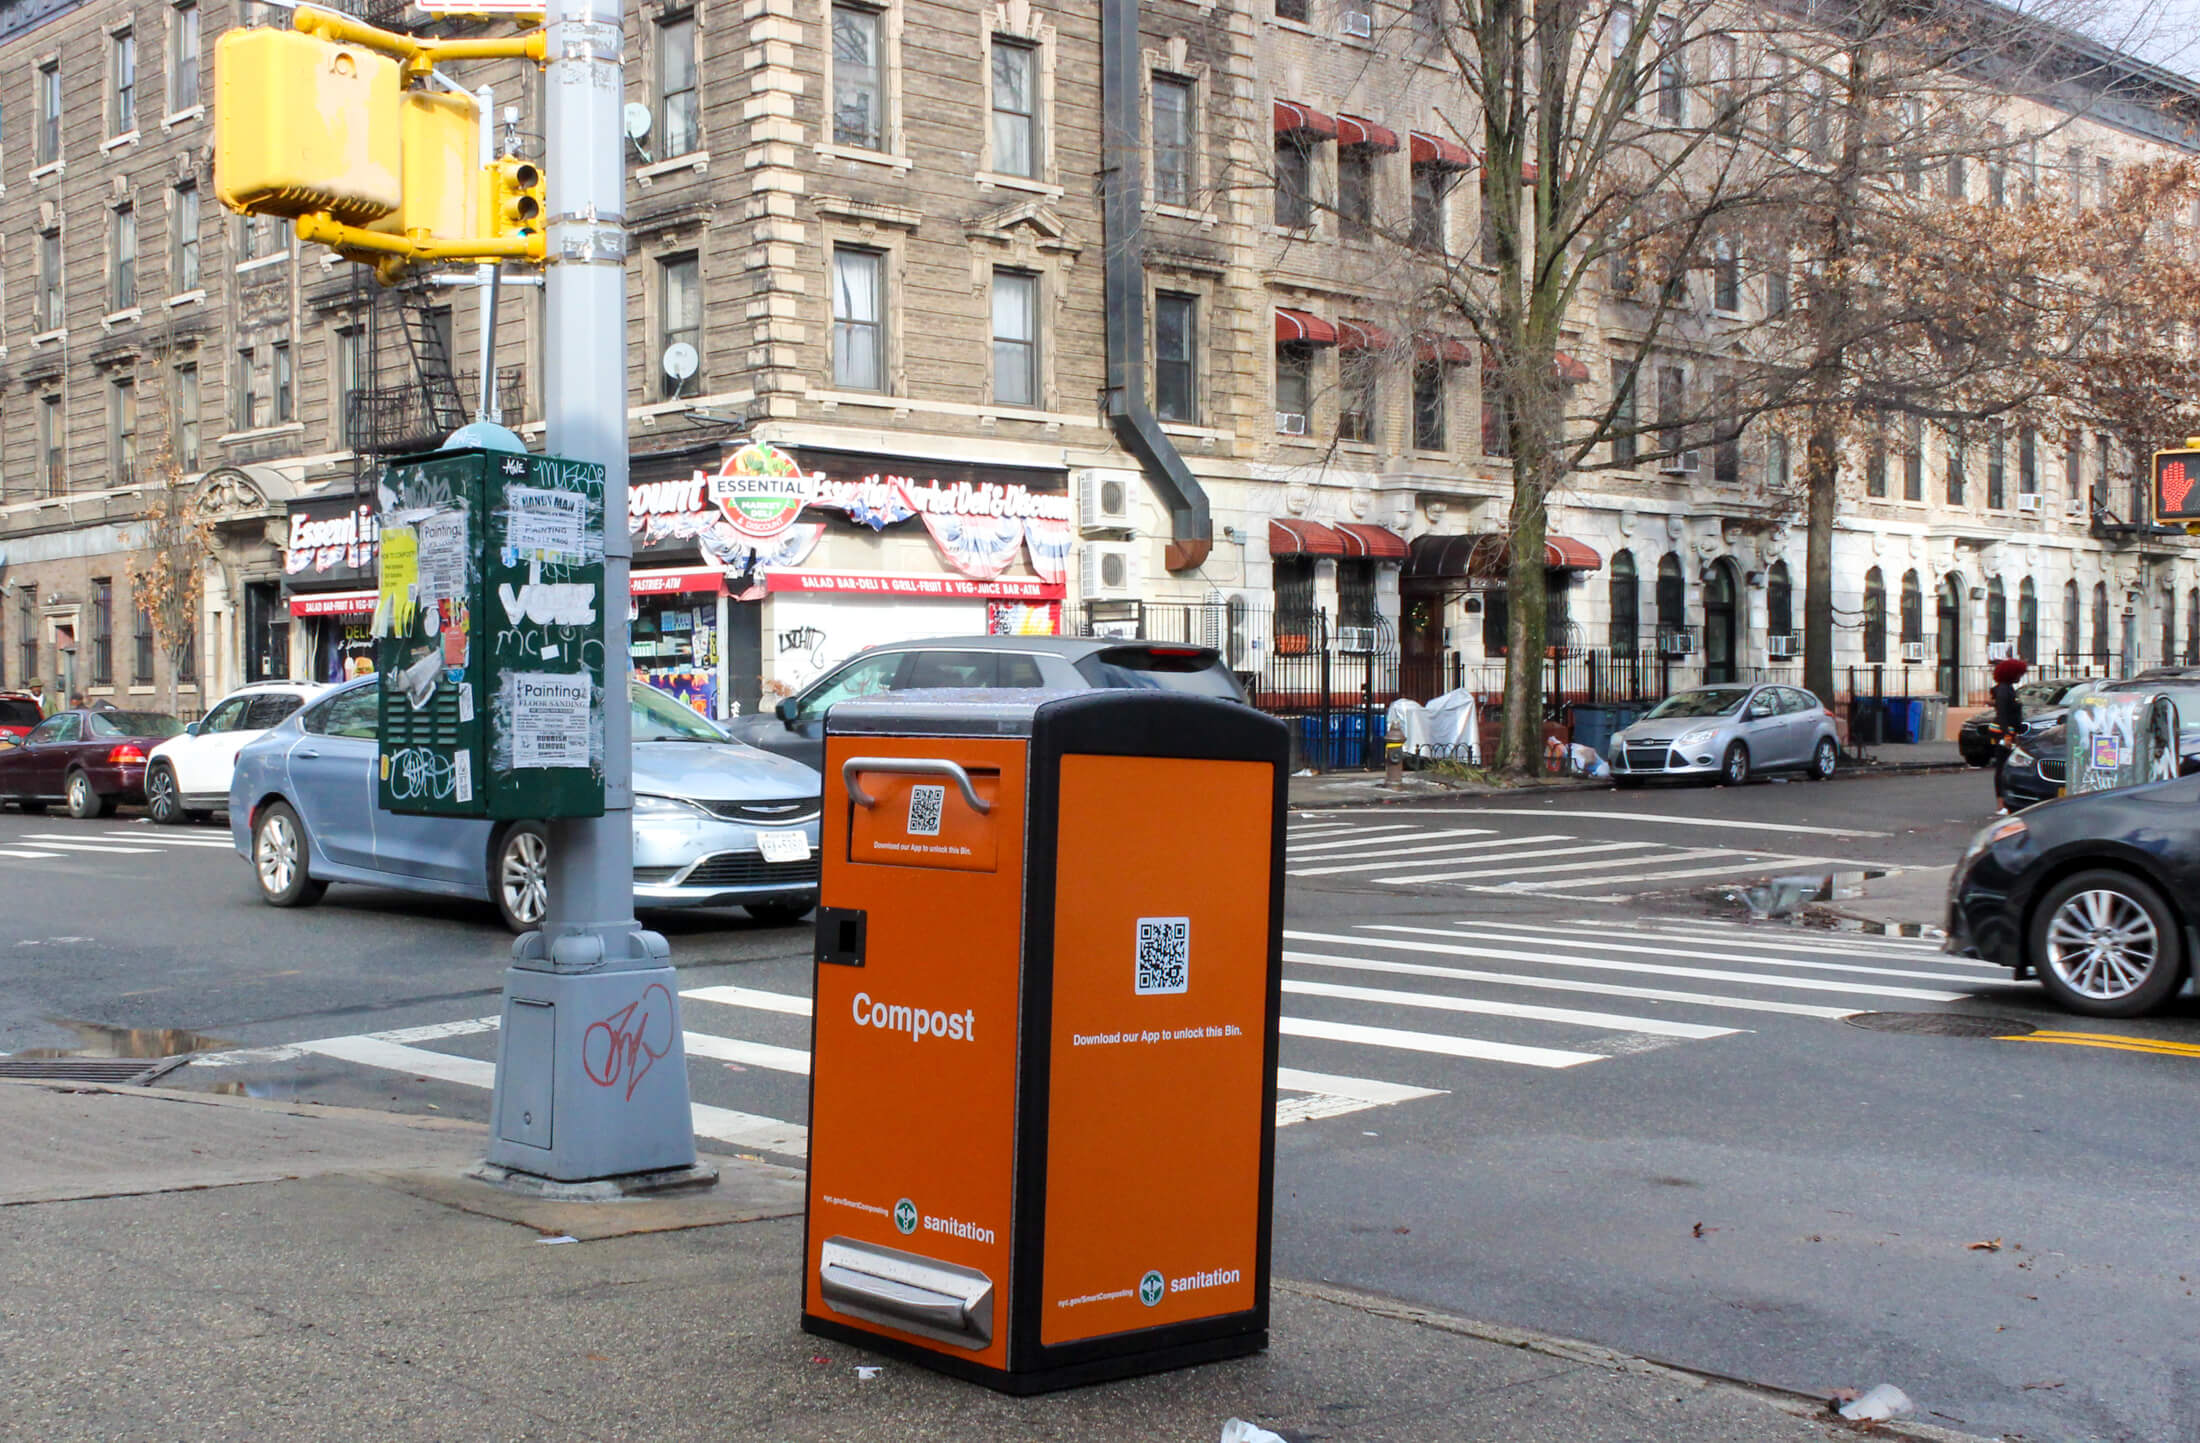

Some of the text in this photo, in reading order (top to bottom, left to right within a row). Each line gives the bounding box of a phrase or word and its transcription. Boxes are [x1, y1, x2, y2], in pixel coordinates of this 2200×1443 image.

[717, 480, 805, 494] ESSENTIAL
[425, 526, 459, 538] Painting
[801, 576, 834, 588] SALAD
[881, 579, 890, 590] &
[945, 582, 953, 592] &
[525, 684, 580, 700] Painting
[873, 840, 899, 850] Download
[911, 843, 922, 853] App
[949, 846, 959, 854] this
[852, 991, 975, 1042] Compost
[1073, 1024, 1243, 1046] Download our App to unlock this Bin.
[923, 1215, 995, 1245] sanitation
[1170, 1267, 1241, 1293] sanitation
